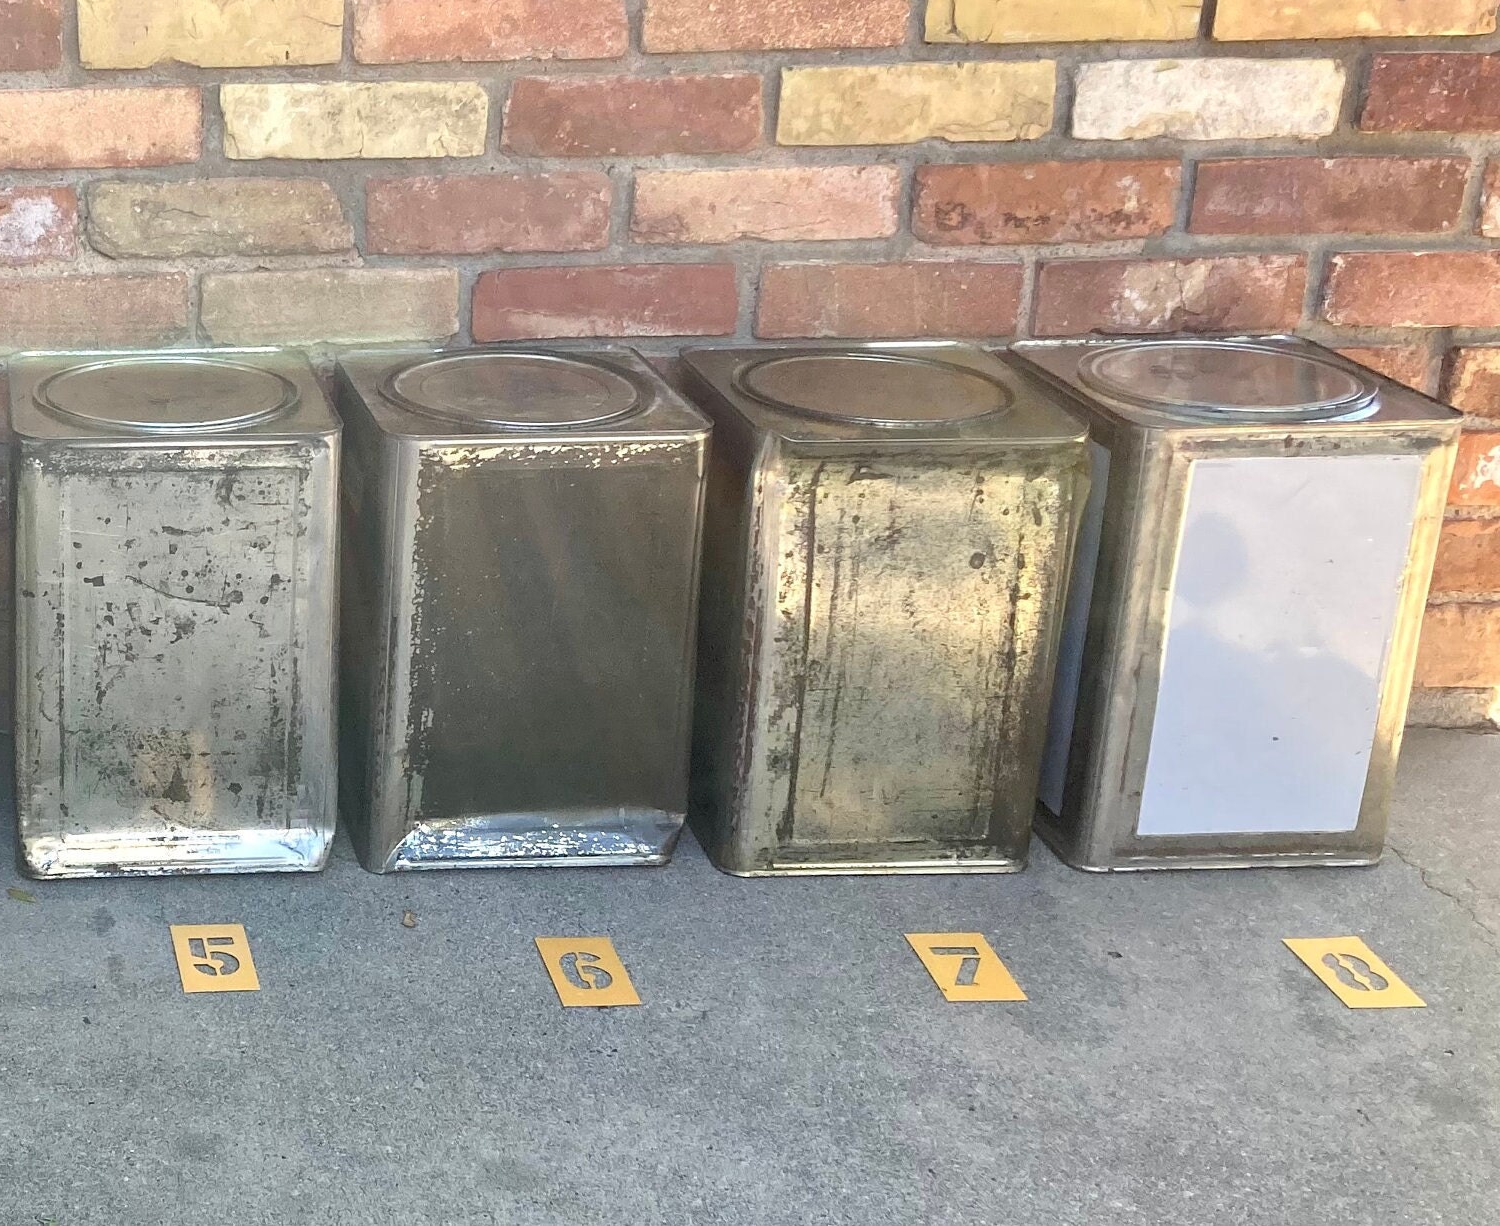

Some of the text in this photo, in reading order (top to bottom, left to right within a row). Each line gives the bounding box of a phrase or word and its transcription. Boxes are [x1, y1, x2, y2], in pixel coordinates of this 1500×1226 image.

[188, 937, 239, 976] 5
[559, 952, 613, 989] 6
[929, 947, 980, 985] 7
[1321, 953, 1388, 991] 8
